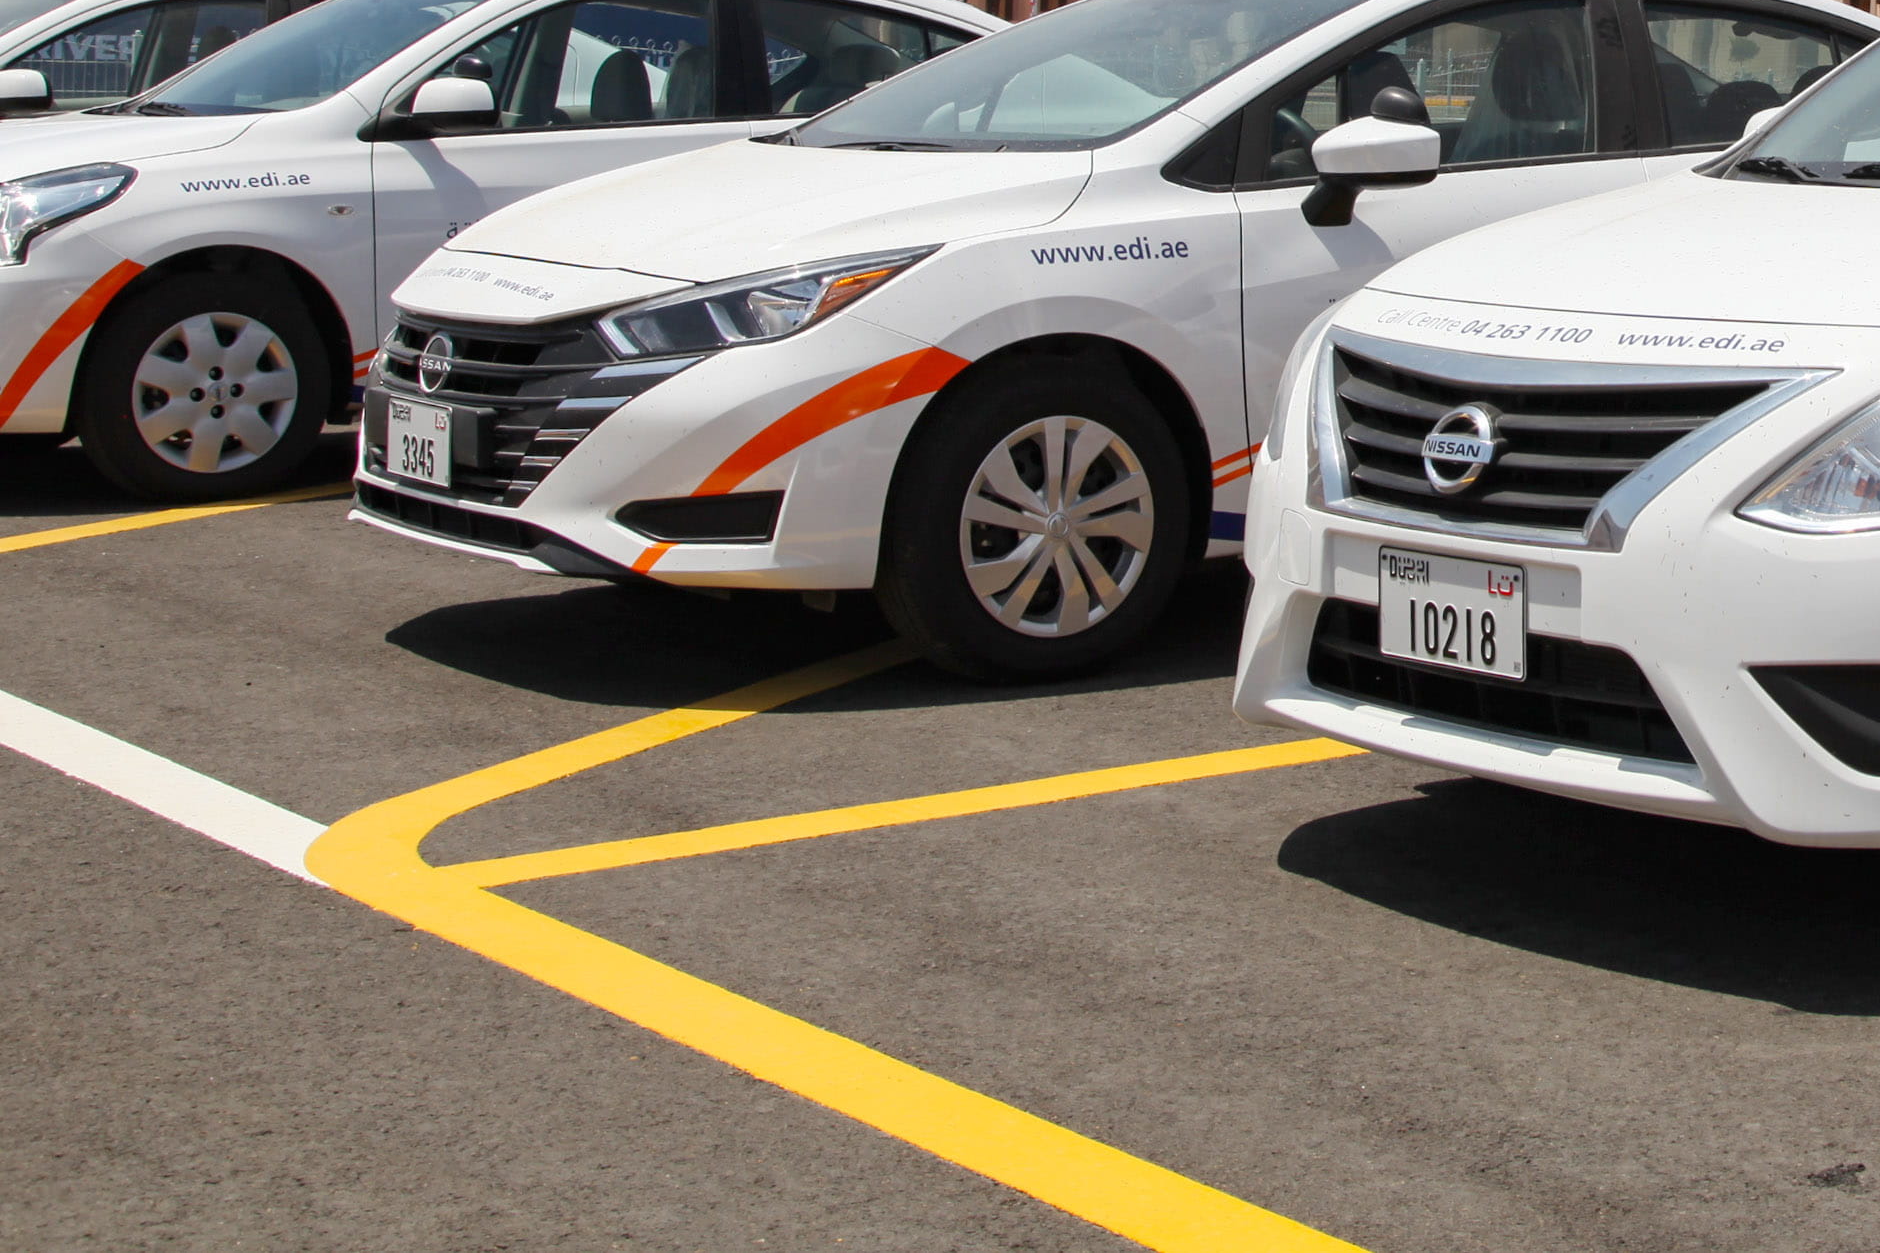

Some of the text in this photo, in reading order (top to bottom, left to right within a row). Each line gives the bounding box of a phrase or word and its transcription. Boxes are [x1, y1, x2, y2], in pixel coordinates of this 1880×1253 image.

[181, 172, 311, 193] www.edi.ae
[1031, 236, 1188, 265] www.edi.ae
[493, 277, 554, 301] www.edi.ae
[1377, 308, 1785, 353] Call Centre 04 263 1100 www.edi.ae
[420, 356, 452, 372] ISSAN
[402, 434, 434, 478] 3345
[1424, 439, 1481, 458] NISSAN
[1410, 599, 1496, 666] 10218
